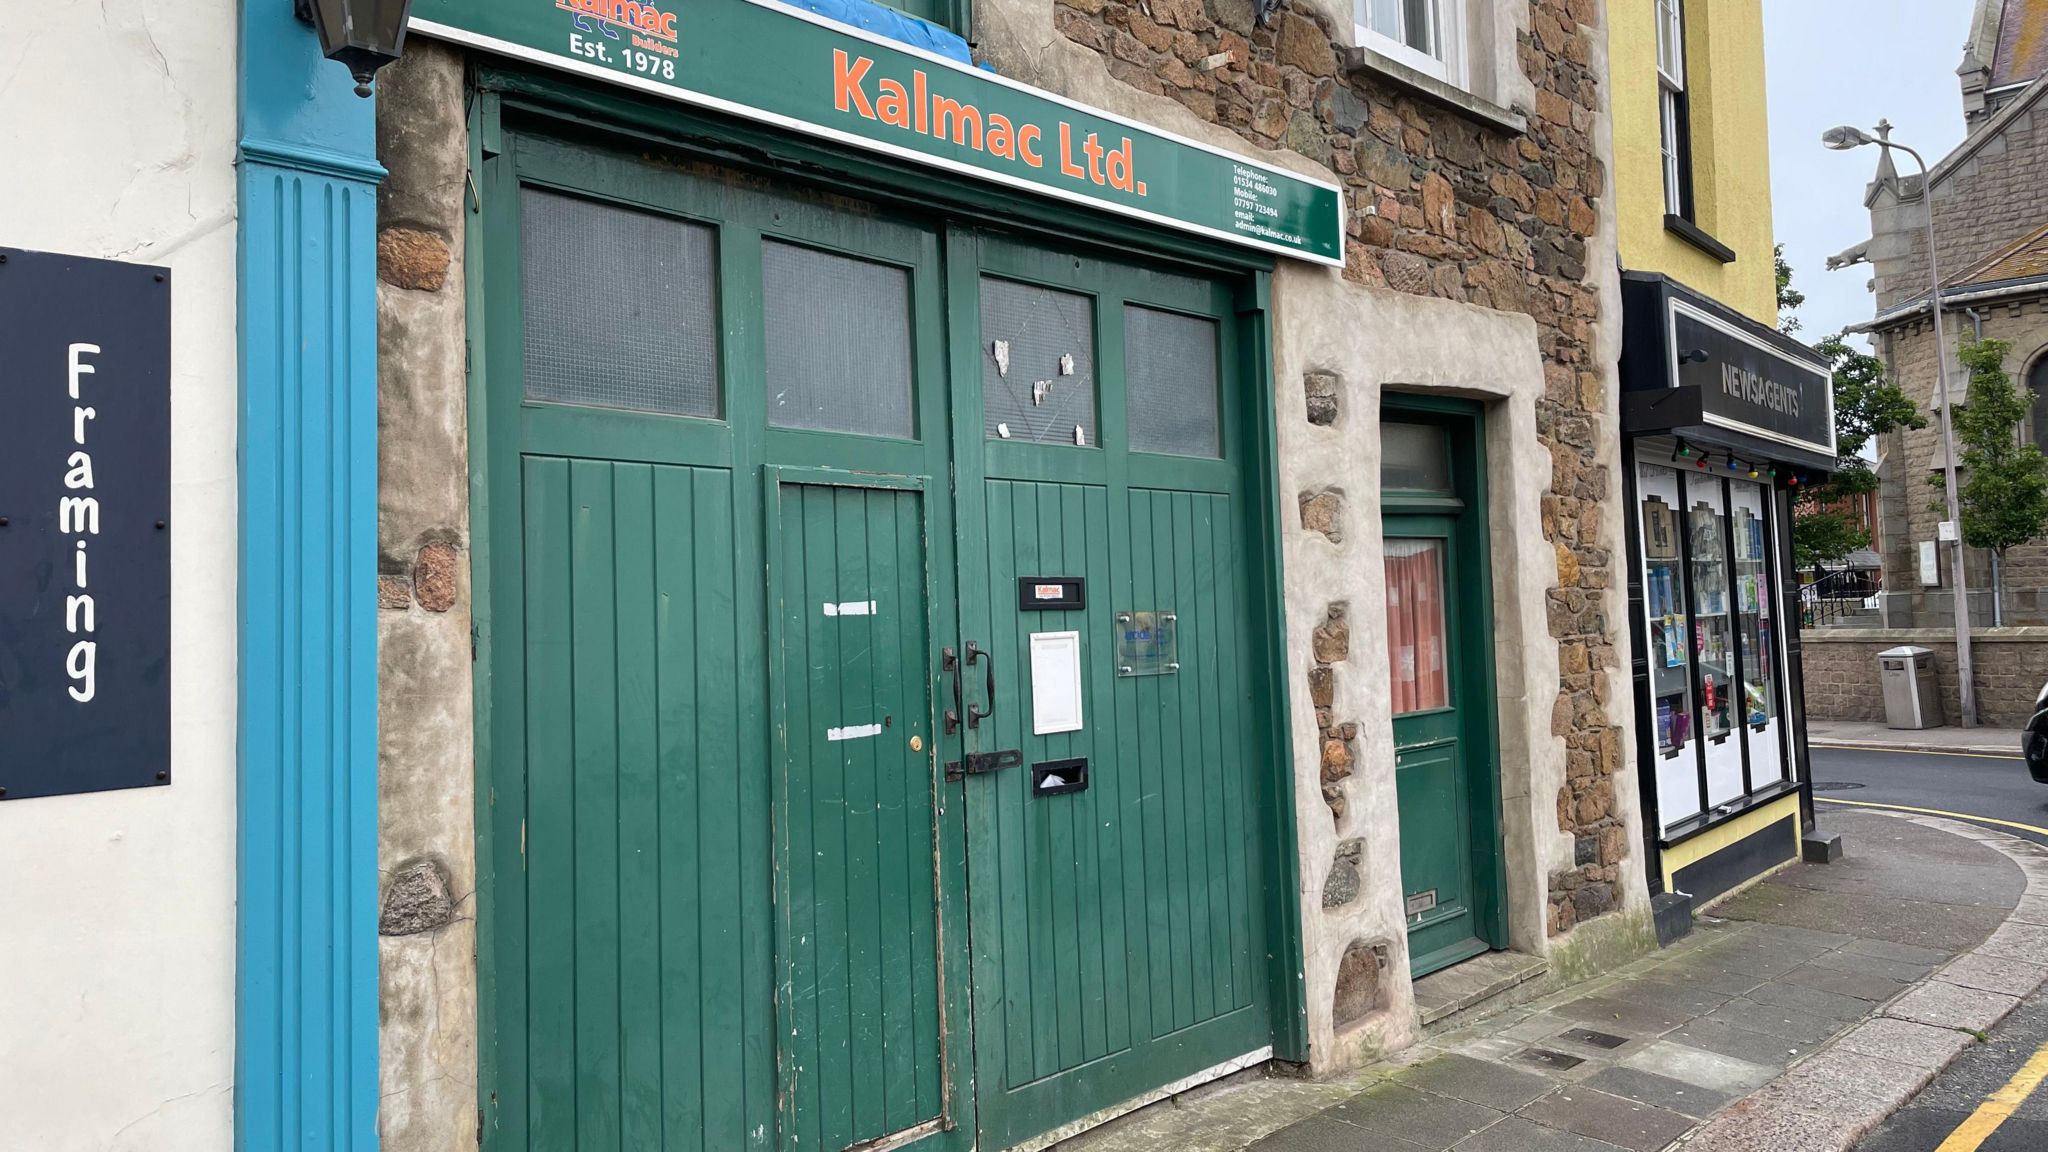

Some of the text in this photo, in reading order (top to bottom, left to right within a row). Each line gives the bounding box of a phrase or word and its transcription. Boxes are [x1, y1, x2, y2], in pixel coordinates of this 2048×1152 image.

[556, 0, 677, 38] almac
[569, 33, 675, 80] Est. 1978
[631, 34, 679, 58] Builders
[833, 48, 1147, 197] Kalmac Ltd.
[1233, 165, 1268, 183] Telephone:
[1234, 175, 1253, 189] 01534
[1234, 186, 1258, 201] Mobile:
[1234, 197, 1278, 217] 07797 723494
[1234, 210, 1254, 222] email:
[1235, 220, 1302, 244] admin@kalmac.co.uk
[59, 343, 101, 703] Framing
